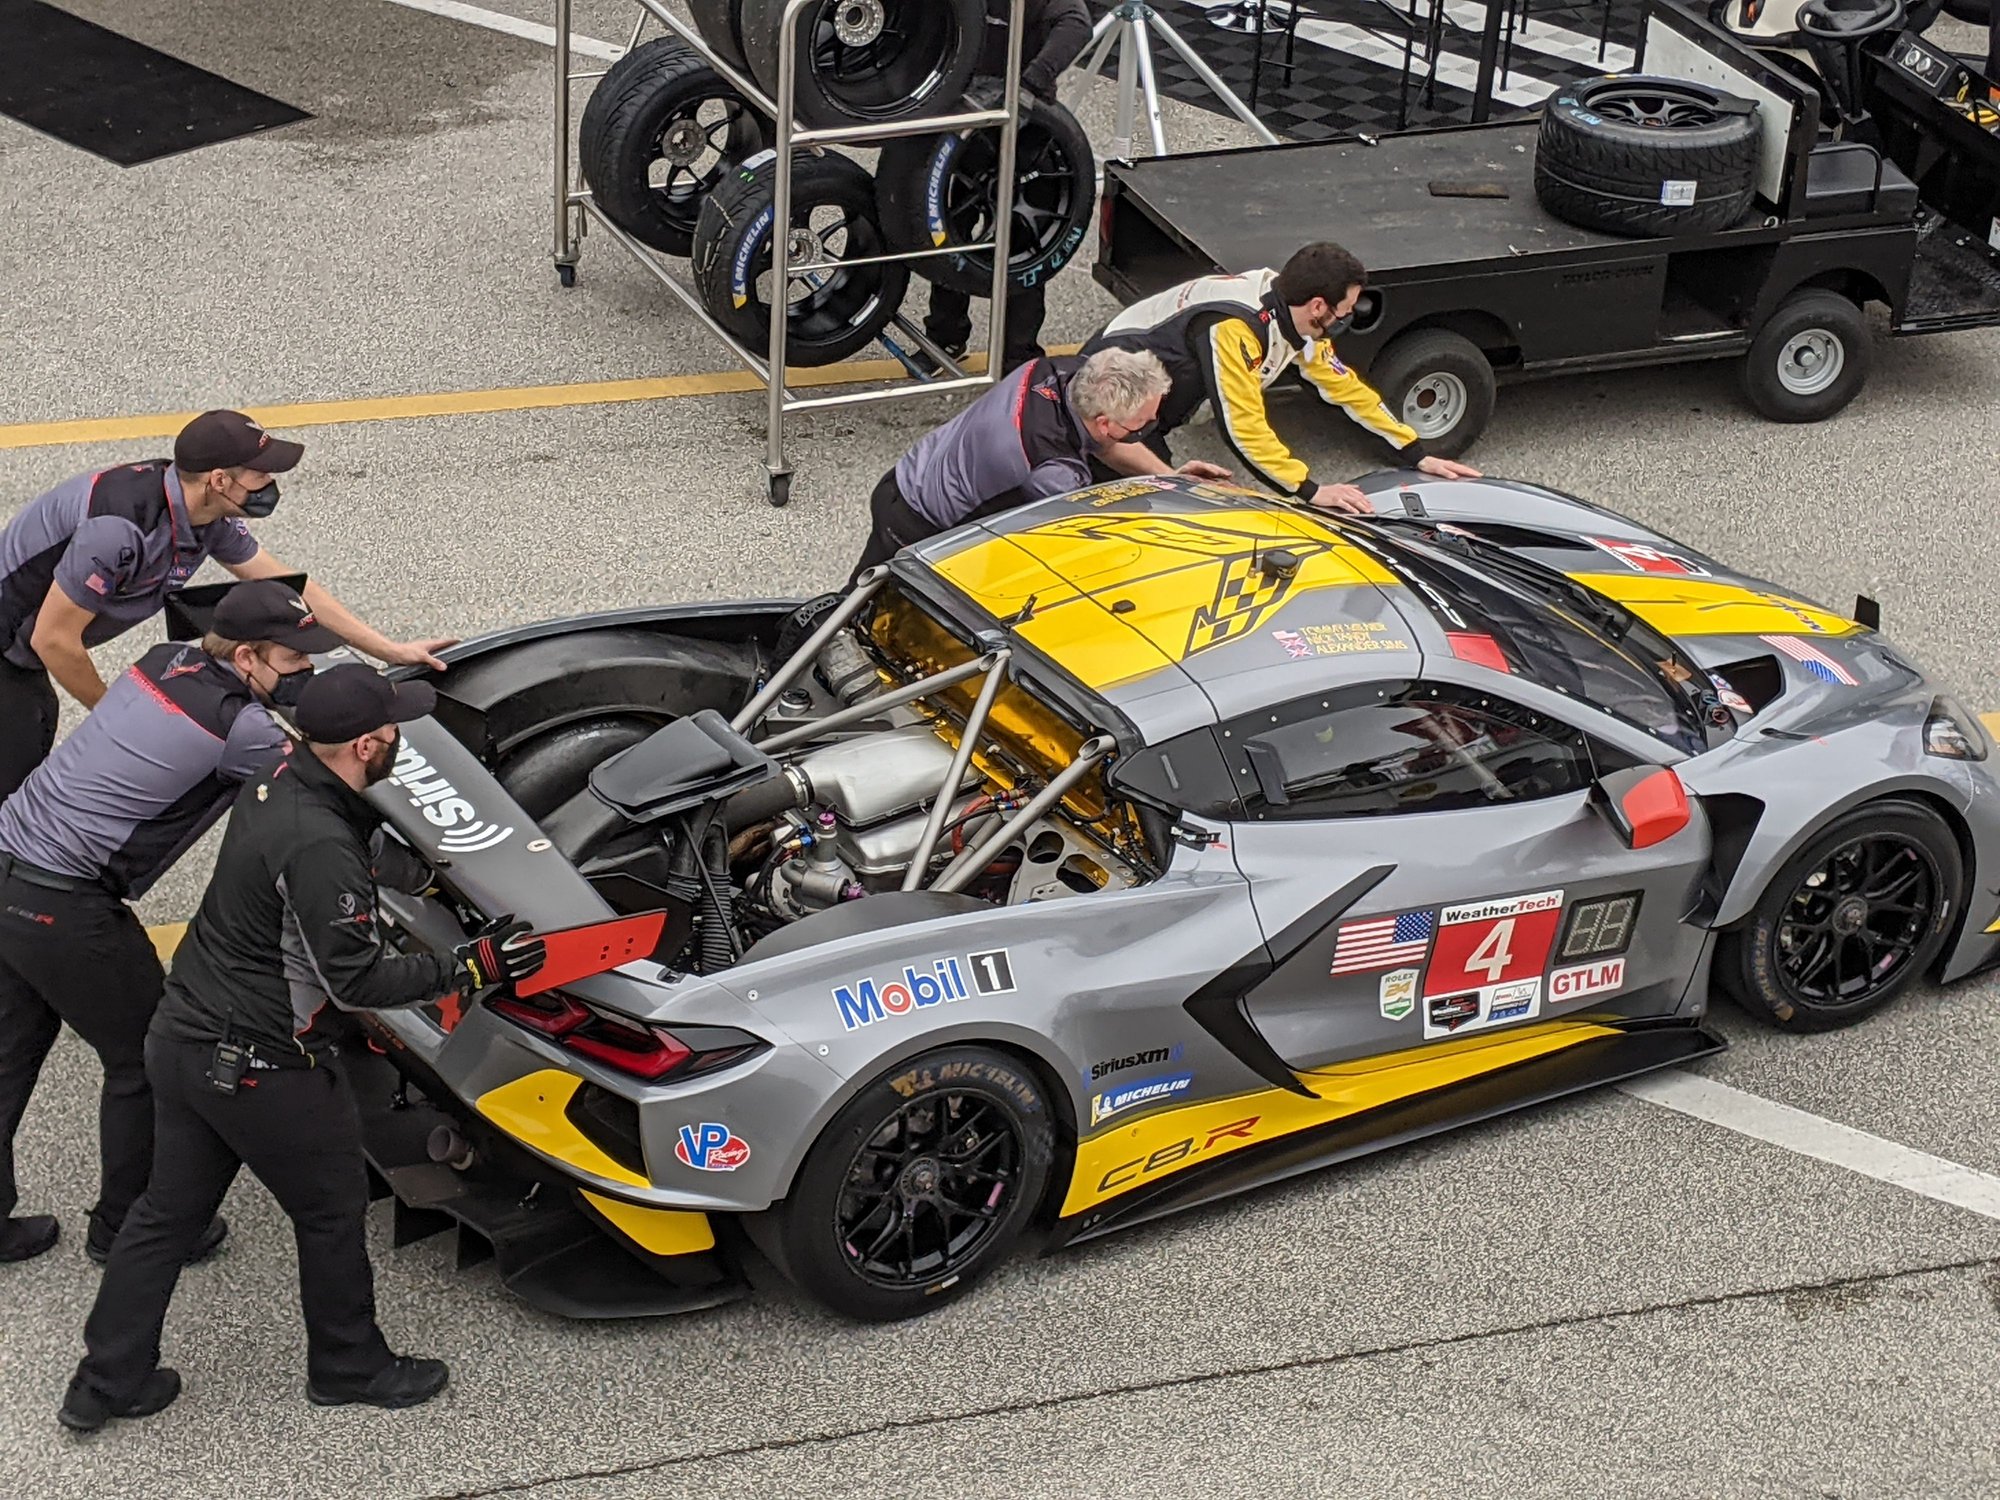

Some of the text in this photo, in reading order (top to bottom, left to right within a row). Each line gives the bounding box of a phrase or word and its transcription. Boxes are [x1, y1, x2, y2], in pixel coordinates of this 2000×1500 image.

[928, 142, 951, 218] MICHELIN
[735, 211, 770, 281] MICHELIN
[1446, 896, 1556, 922] WeatherTech
[1464, 918, 1516, 982] 4
[833, 957, 969, 1031] Mobil
[1385, 972, 1415, 984] ROLEX
[1553, 963, 1620, 994] GTLM
[939, 1062, 1035, 1105] MICHELIN
[1114, 1078, 1191, 1107] MICHELIN
[679, 1123, 731, 1168] VP
[709, 1148, 748, 1163] Racing
[1097, 1116, 1261, 1193] C8.R
